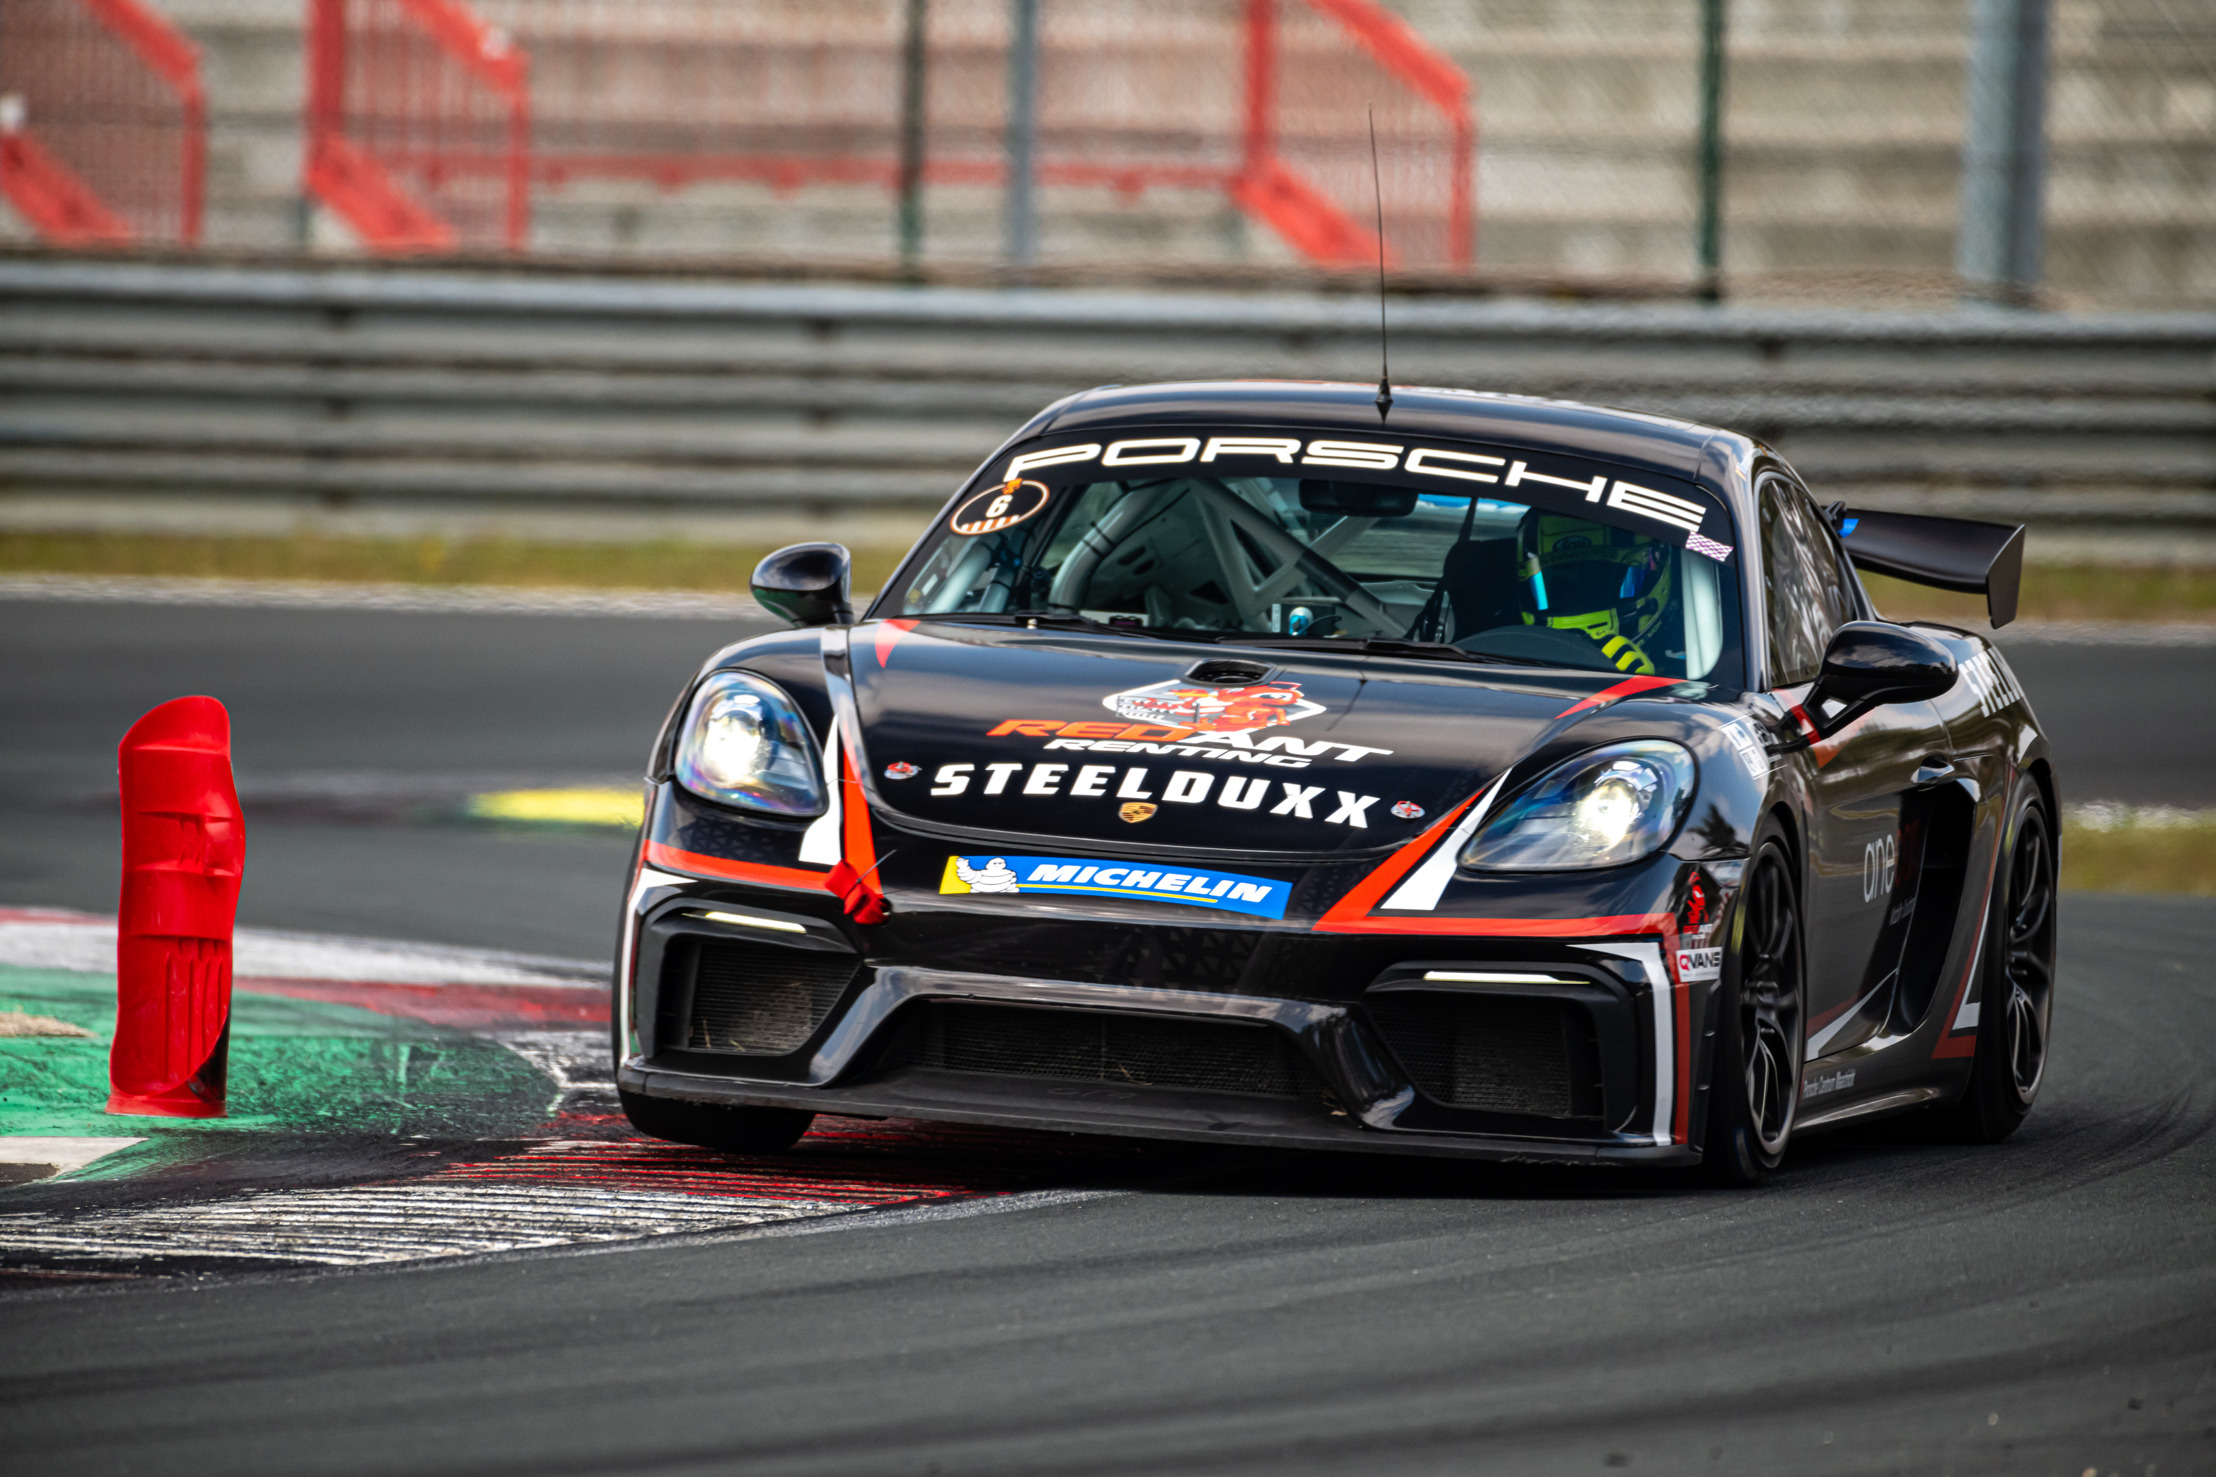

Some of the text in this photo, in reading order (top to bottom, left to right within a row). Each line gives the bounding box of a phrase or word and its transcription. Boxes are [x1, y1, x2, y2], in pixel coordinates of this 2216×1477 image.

[1004, 437, 1706, 532] PORSCHE
[985, 494, 1013, 518] 6
[1043, 738, 1313, 768] RENTING
[930, 763, 1381, 829] STEELDUXX
[1027, 864, 1273, 903] MICHELIN
